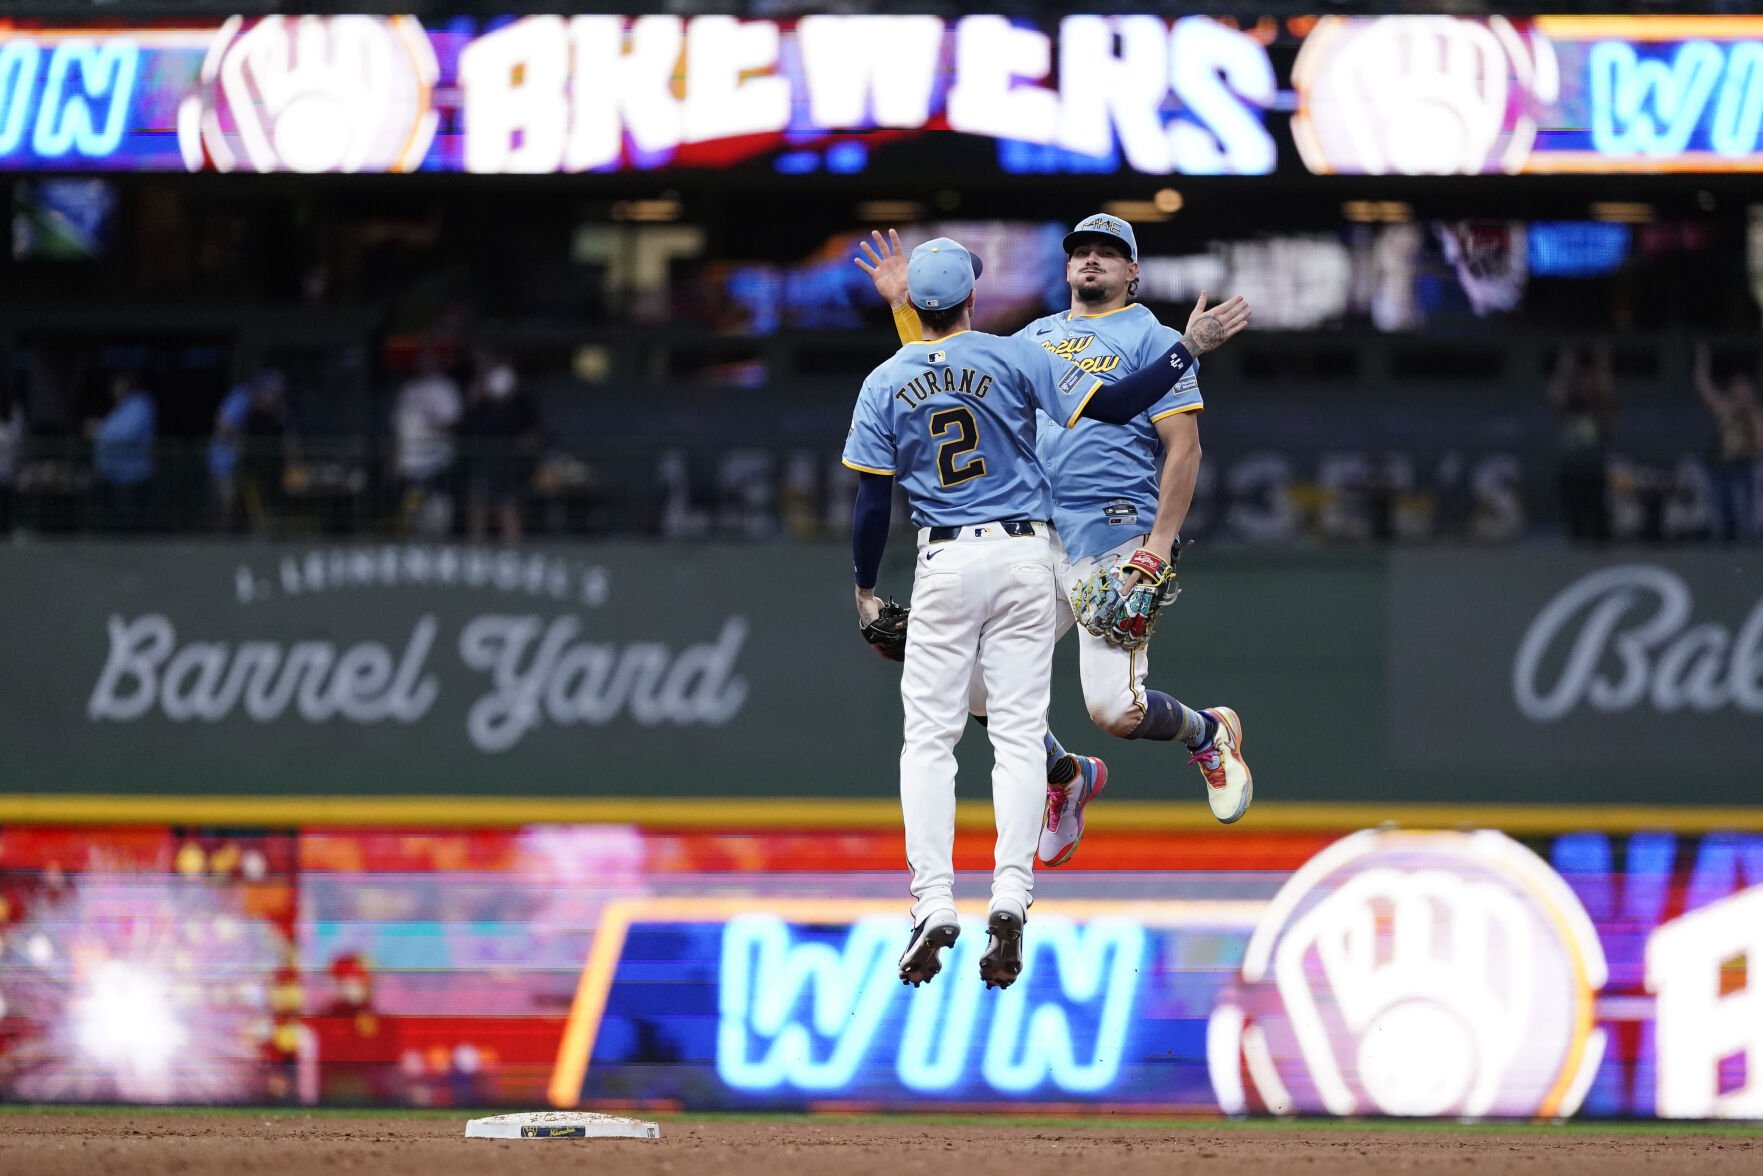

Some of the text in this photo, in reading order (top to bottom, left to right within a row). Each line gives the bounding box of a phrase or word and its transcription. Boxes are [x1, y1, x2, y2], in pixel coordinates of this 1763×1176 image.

[458, 14, 1277, 175] BREWERS
[895, 367, 993, 410] TURANG
[929, 406, 987, 488] 2
[86, 613, 750, 753] Barrel Yard
[717, 912, 1146, 1093] WIN
